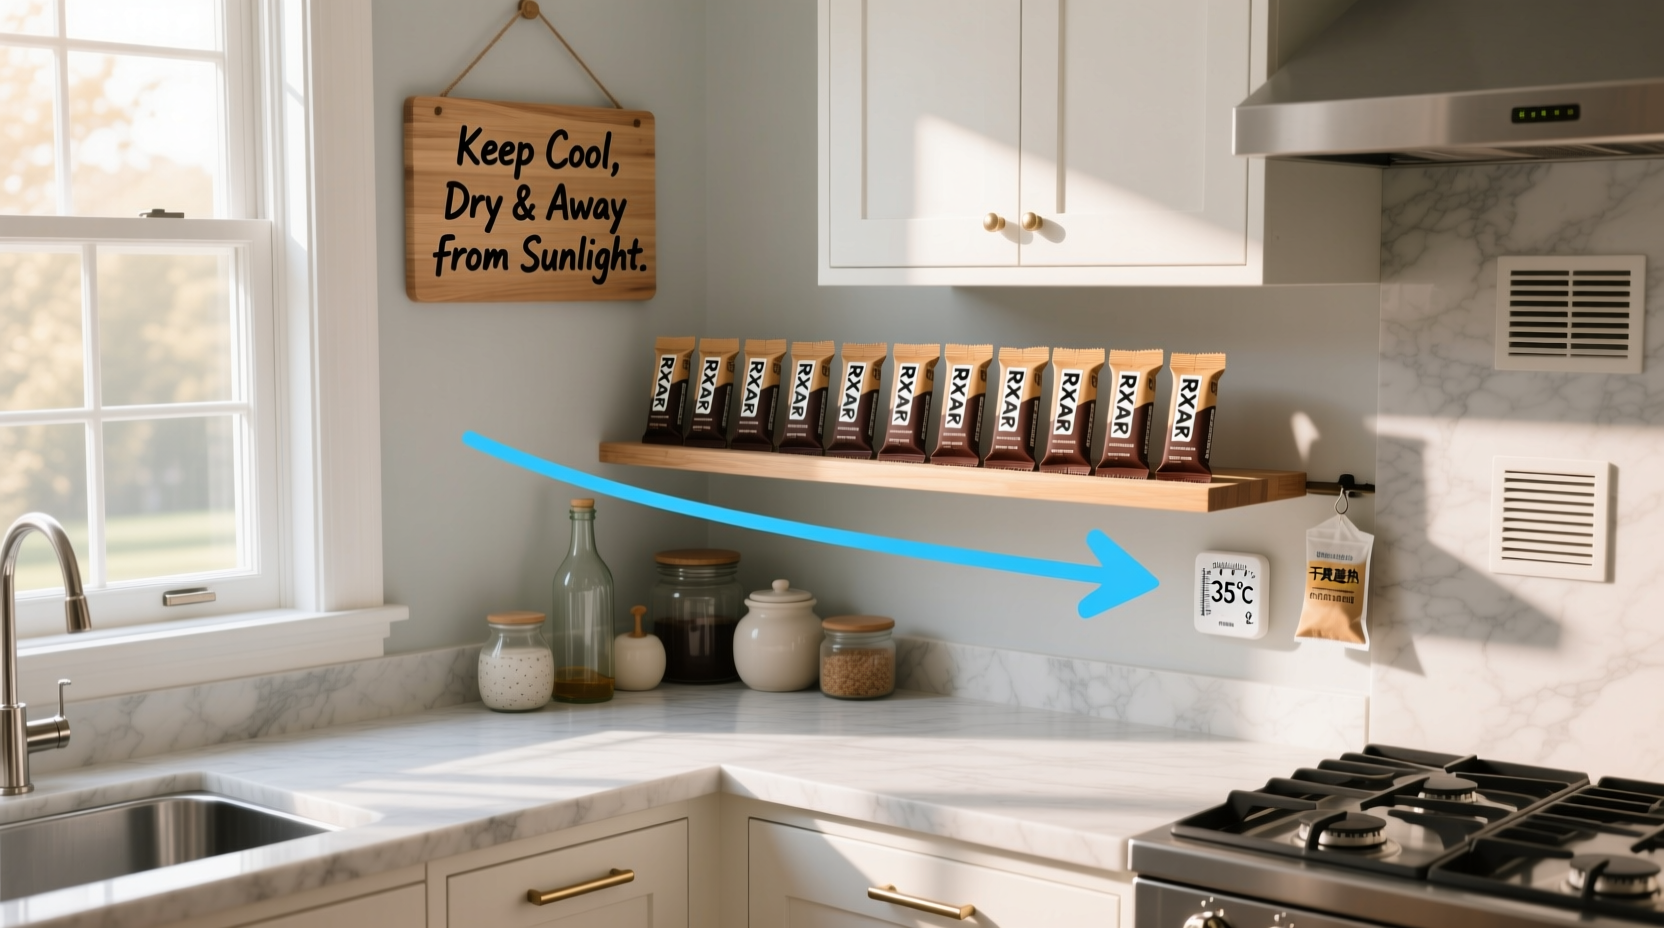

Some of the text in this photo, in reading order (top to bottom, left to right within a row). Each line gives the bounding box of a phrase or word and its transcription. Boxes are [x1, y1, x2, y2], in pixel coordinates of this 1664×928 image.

[456, 125, 620, 180] Keep Cool,
[444, 181, 627, 235] Dry & Away
[433, 234, 647, 285] from Sunlight.
[654, 357, 675, 409] RXAR
[697, 360, 719, 411] RXAR
[743, 361, 765, 414] RXAR
[791, 363, 813, 417] RXAR
[841, 365, 865, 420] RXAR
[894, 366, 917, 421] RXAR
[947, 368, 970, 425] RXAR
[1001, 371, 1024, 428] RXAR
[1055, 373, 1080, 432] RXAR
[1113, 375, 1138, 434] RXAR
[1174, 379, 1199, 438] RXAR
[1211, 580, 1254, 604] 35°C
